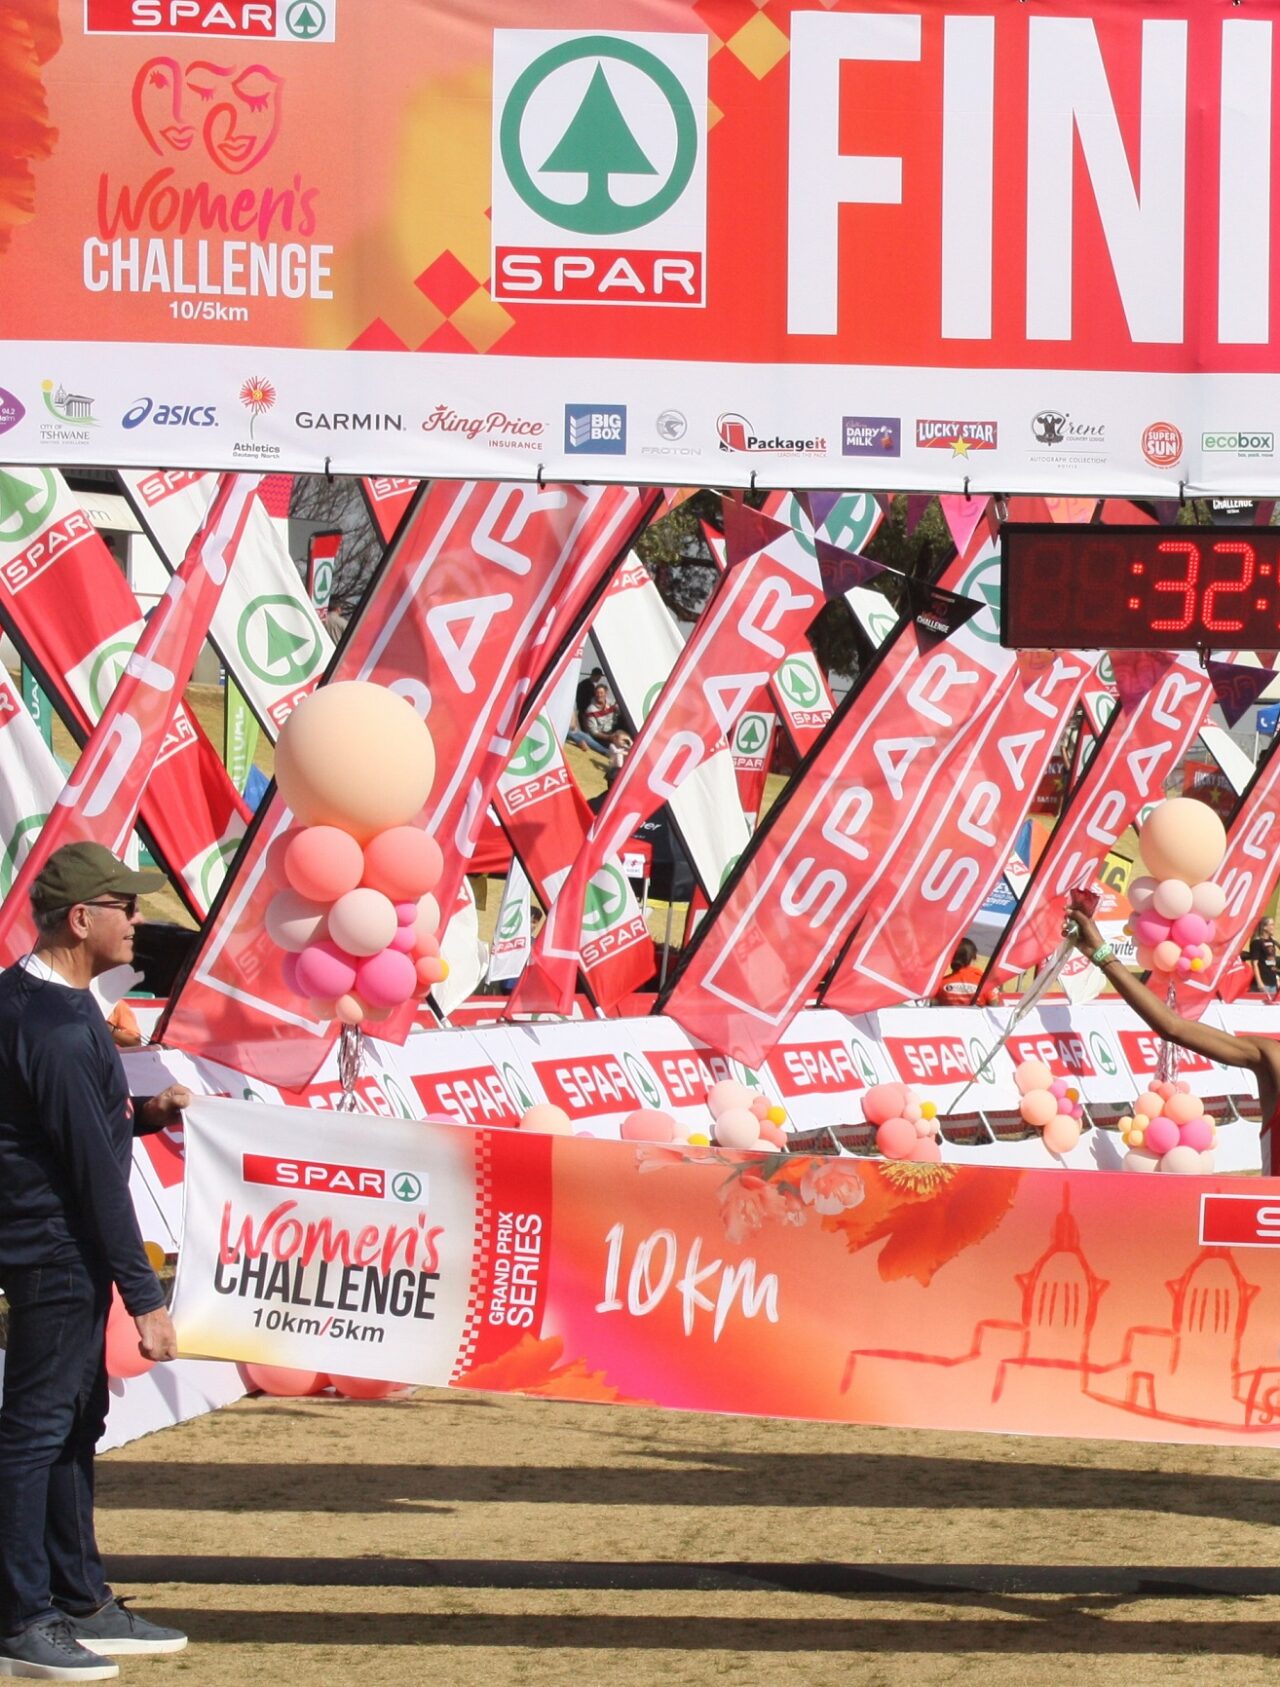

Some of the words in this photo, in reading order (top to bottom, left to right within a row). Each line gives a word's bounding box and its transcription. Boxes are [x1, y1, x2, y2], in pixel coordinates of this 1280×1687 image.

[131, 0, 274, 31] SPAR
[99, 167, 318, 243] Women's
[83, 237, 335, 300] CHALLENGE
[502, 254, 696, 296] SPAR
[168, 300, 250, 324] 10/5km
[40, 431, 90, 440] TSHWANE
[295, 411, 403, 432] GARMIN
[591, 413, 621, 428] BIG
[591, 427, 621, 440] BOX
[846, 428, 880, 437] DAIRY
[918, 423, 960, 442] LUCKY
[963, 424, 994, 443] STAR
[1148, 431, 1176, 441] SUPER
[233, 442, 280, 455] Athletics
[488, 440, 543, 450] INSURANCE
[641, 447, 701, 456] PROTON
[846, 437, 873, 447] MILK
[1147, 441, 1177, 456] SUN
[1205, 432, 1271, 448] ecobox
[6, 514, 89, 584] SPAR
[916, 615, 951, 635] CHALLENGE
[793, 711, 834, 726] SPAR
[508, 771, 569, 805] SPAR
[781, 654, 980, 928] SPAR
[1056, 671, 1202, 894] SPAR
[582, 921, 645, 965] SPAR
[783, 1045, 852, 1085] SPAR
[903, 1044, 973, 1078] SPAR
[1018, 1039, 1087, 1073] SPAR
[557, 1061, 630, 1109] SPAR
[436, 1081, 510, 1126] SPAR
[276, 1163, 383, 1195] SPAR
[219, 1199, 445, 1276] Women's
[496, 1211, 514, 1250] PRIX
[214, 1246, 440, 1320] CHALLENGE
[507, 1213, 543, 1327] SERIES
[595, 1222, 779, 1342] 10km
[490, 1252, 512, 1326] GRAND
[252, 1306, 385, 1344] 10km/5km
